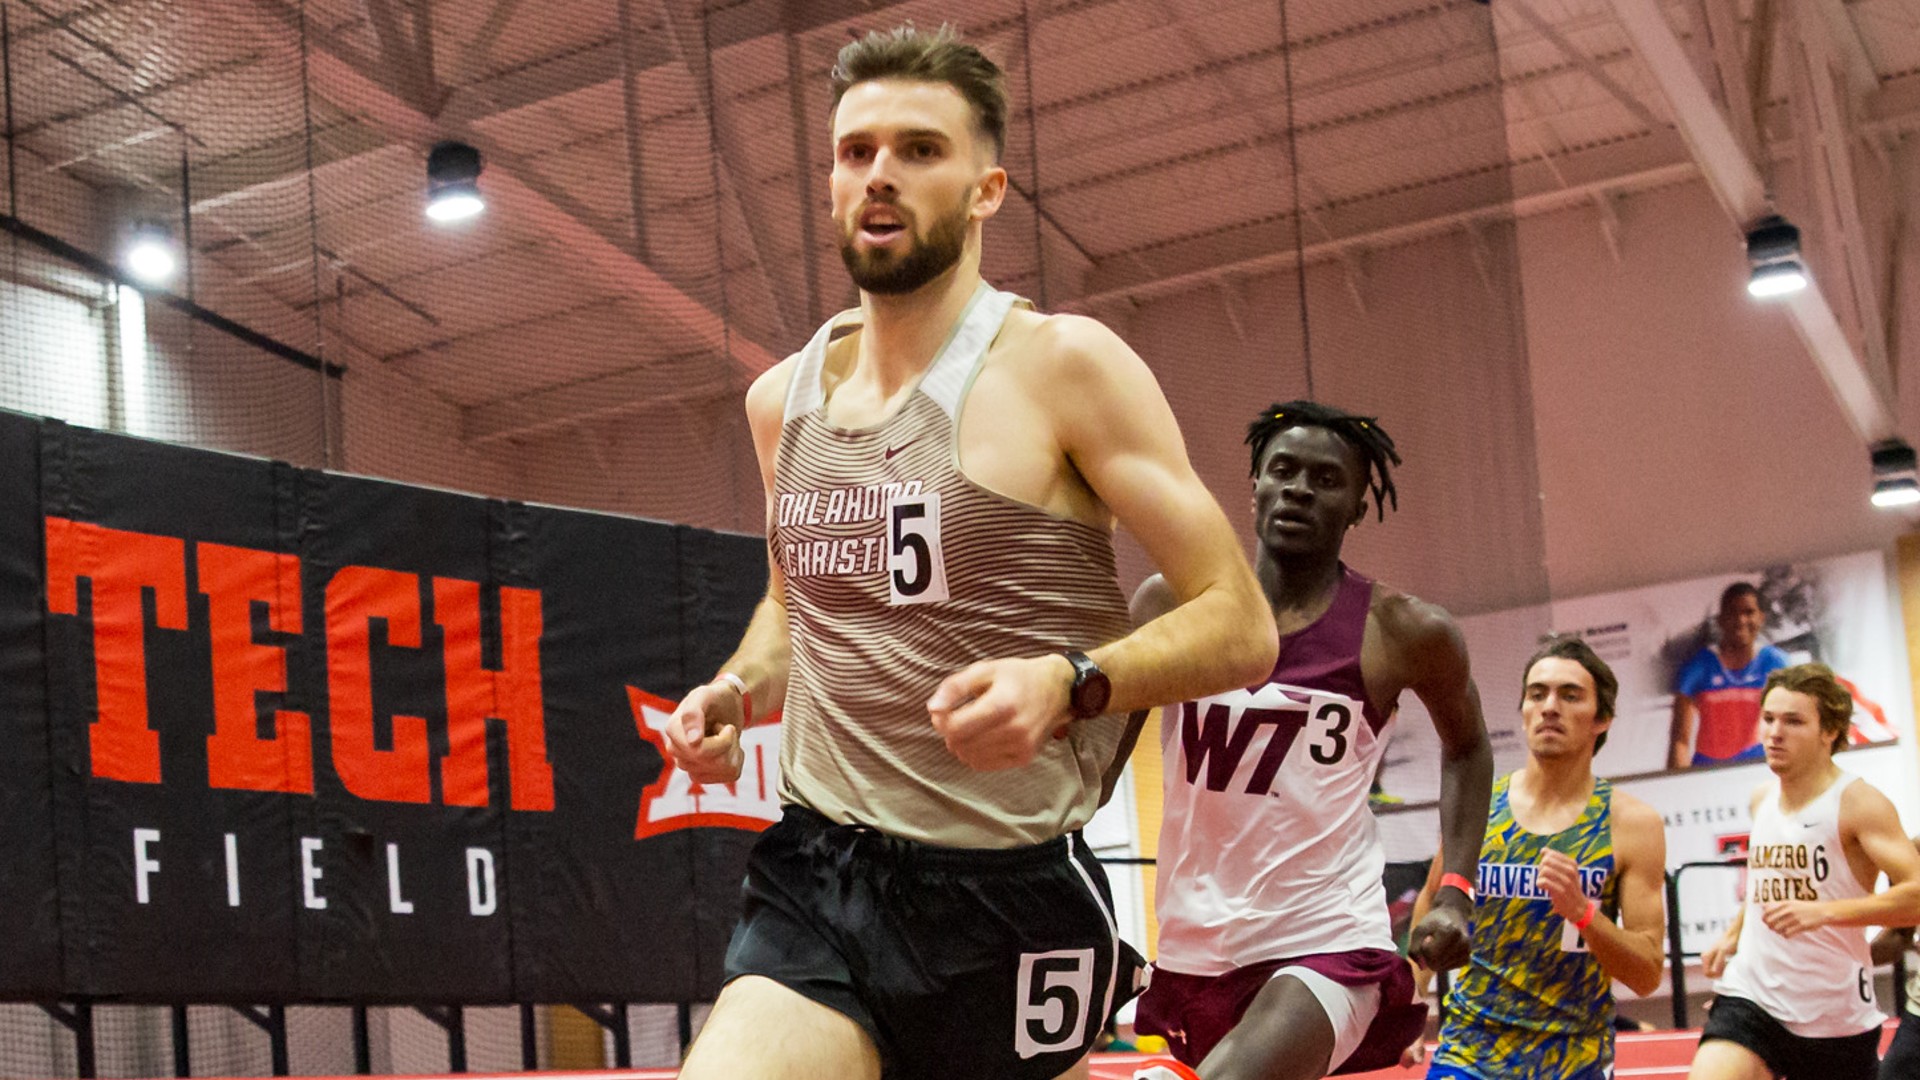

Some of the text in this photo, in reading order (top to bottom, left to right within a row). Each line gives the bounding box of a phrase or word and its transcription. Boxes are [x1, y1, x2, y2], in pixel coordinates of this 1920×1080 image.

[785, 536, 890, 577] CHRISTI
[893, 503, 932, 597] 5
[45, 516, 555, 812] TECH
[1310, 703, 1351, 765] 3
[134, 828, 497, 916] FIELD
[1754, 876, 1818, 902] AGGIES
[1814, 844, 1829, 882] 6
[1026, 957, 1080, 1045] 5
